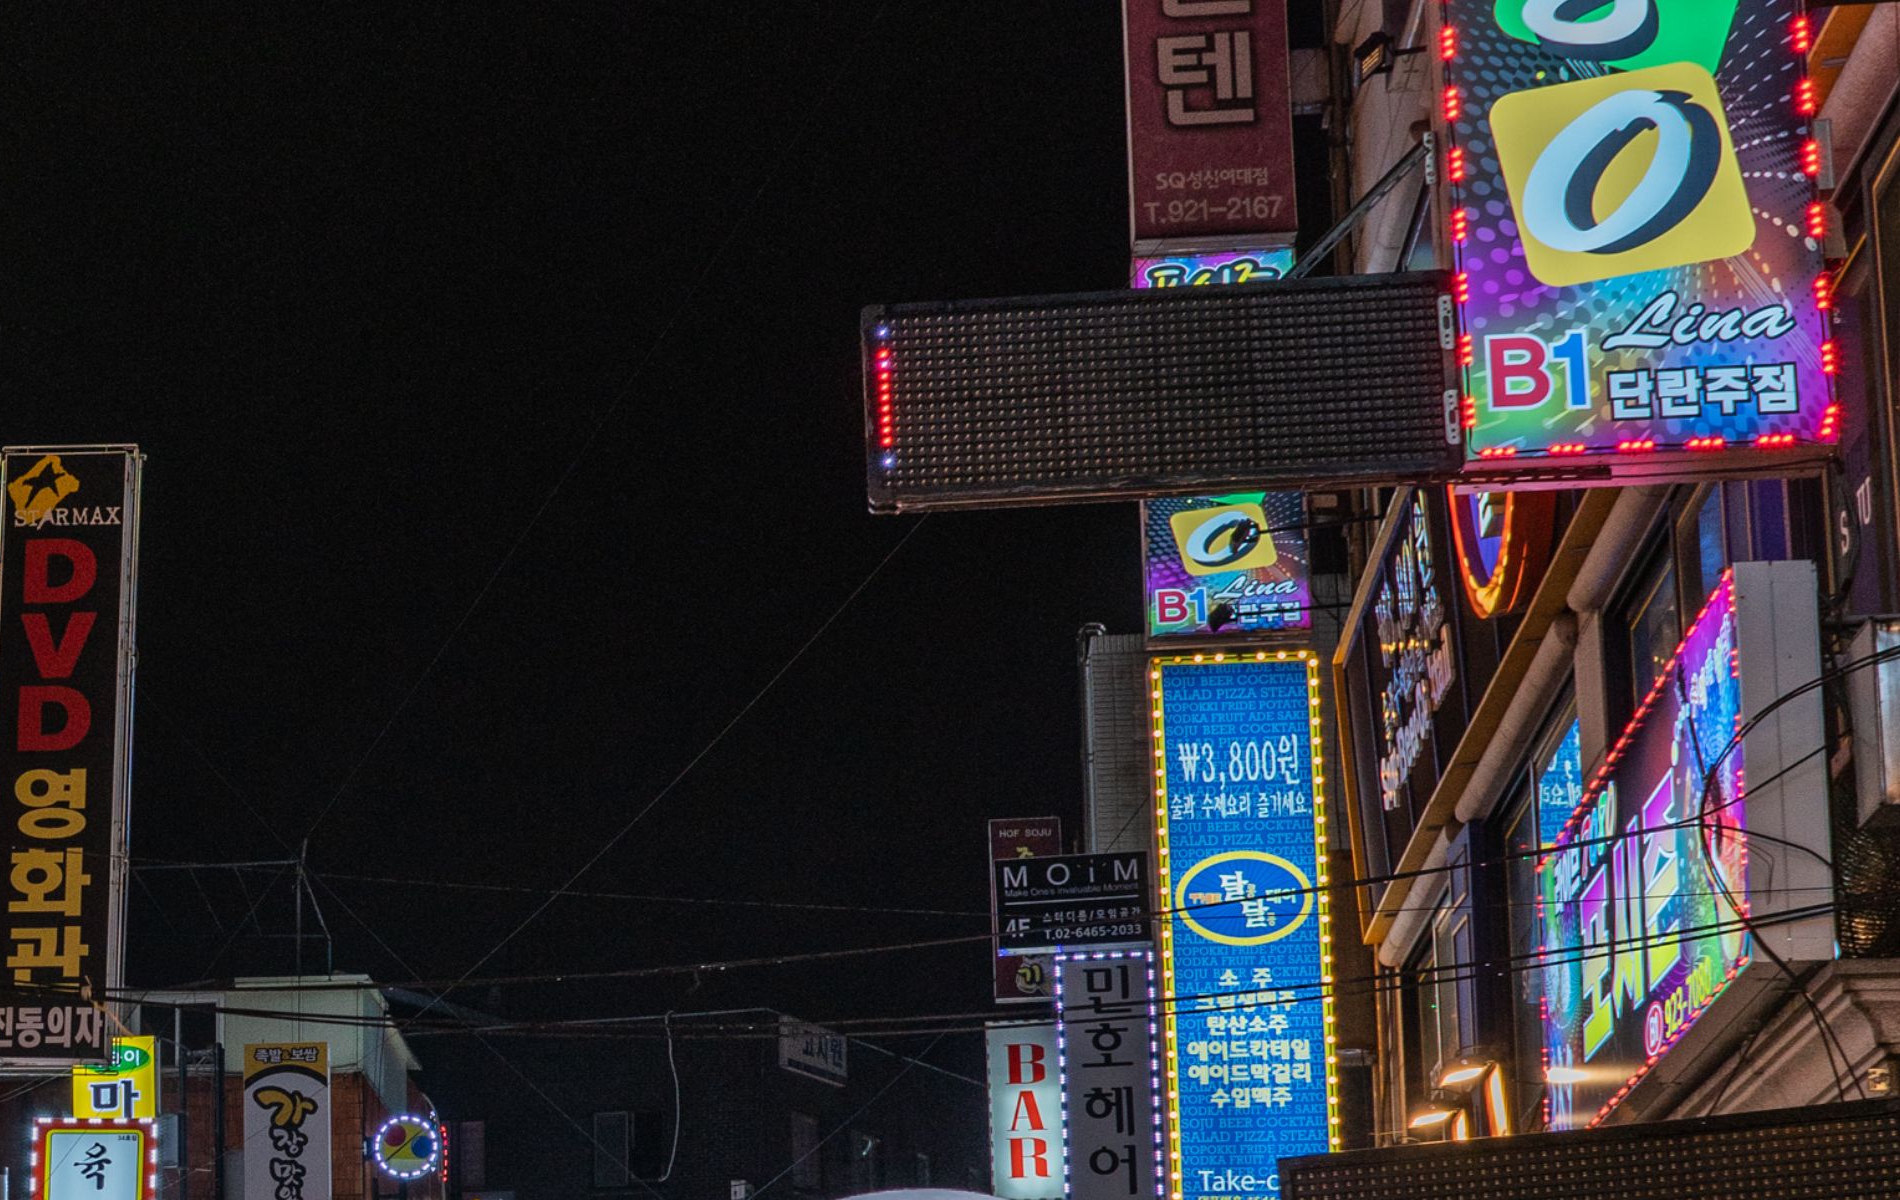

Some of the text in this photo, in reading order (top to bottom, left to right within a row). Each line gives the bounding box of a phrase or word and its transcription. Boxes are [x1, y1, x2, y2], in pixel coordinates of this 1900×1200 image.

[1600, 289, 1798, 352] Lina
[1483, 328, 1592, 412] B1
[1606, 361, 1800, 422] 단란주점
[14, 506, 121, 529] STARMAX
[1155, 586, 1208, 626] B1
[1212, 575, 1299, 601] Lina
[17, 538, 98, 752] DVD
[1164, 673, 1307, 689] SOJU BEER COCKTAIL
[1165, 686, 1307, 701] SALAD PIZZA STEAK
[999, 828, 1020, 839] HOF
[6, 767, 93, 991] 영화관
[1206, 1014, 1290, 1037] 탄산소주
[1082, 966, 1135, 1196] 민호헤어
[1005, 1042, 1051, 1179] BAR
